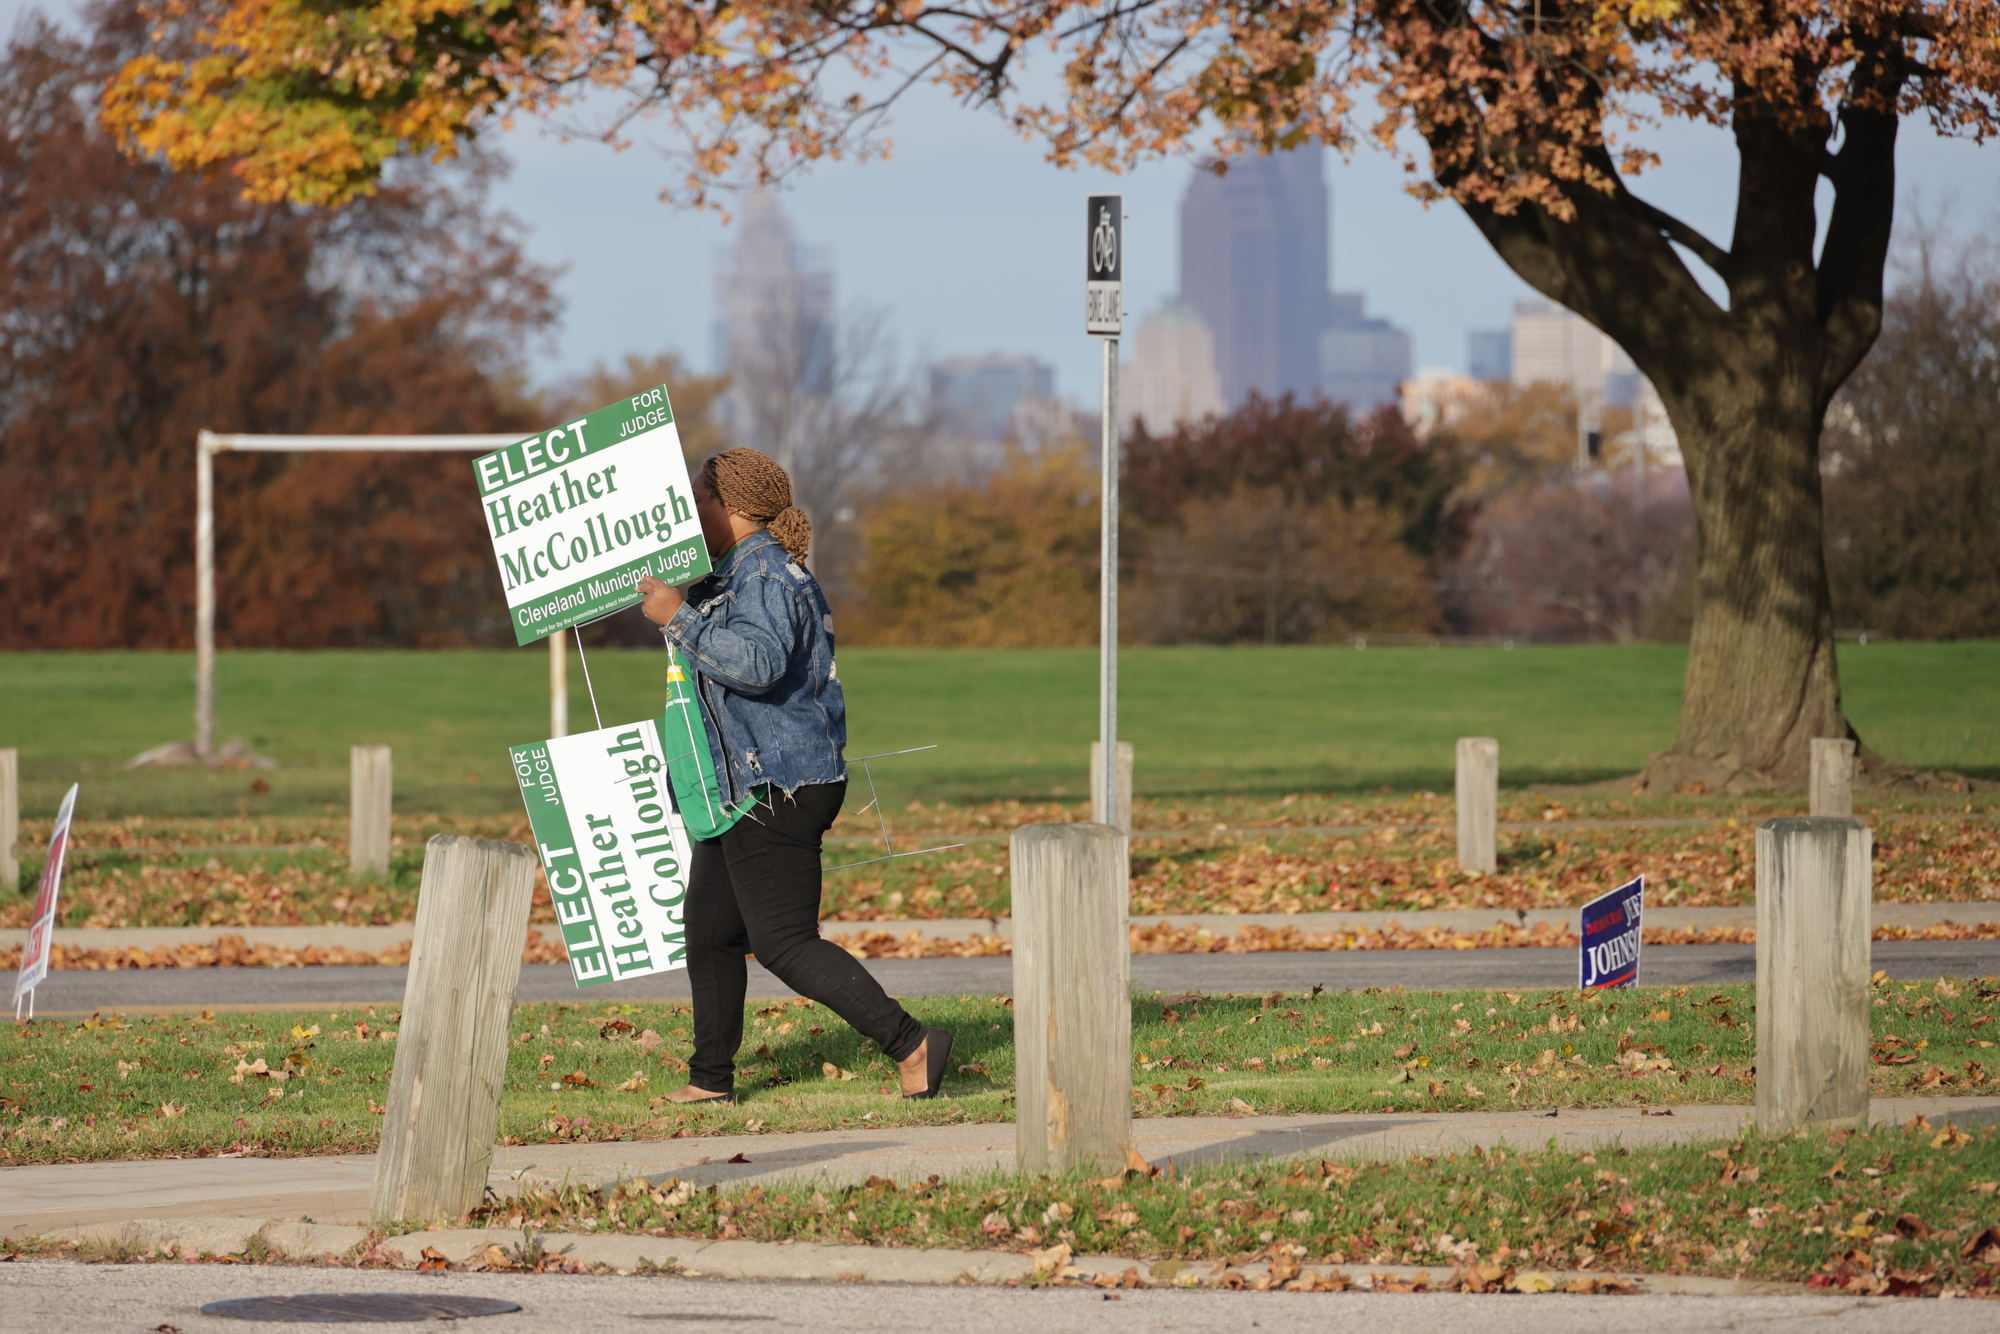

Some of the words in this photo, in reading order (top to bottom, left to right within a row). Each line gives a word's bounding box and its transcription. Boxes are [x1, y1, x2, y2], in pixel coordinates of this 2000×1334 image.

[619, 407, 668, 438] JUDGE
[631, 389, 663, 412] FOR
[478, 418, 588, 492] ELECT
[486, 464, 618, 539] Heather
[500, 485, 693, 591] McCollough
[518, 586, 586, 627] Cleveland
[588, 560, 653, 600] Municipal
[657, 547, 698, 574] Judge
[536, 625, 549, 636] Paid
[563, 617, 572, 625] the
[572, 608, 599, 622] committee
[605, 601, 618, 609] elect
[618, 592, 639, 604] Heather
[675, 571, 692, 582] Judge
[514, 751, 536, 788] FOR
[531, 747, 560, 806] JUDGE
[606, 728, 688, 966] McCollough
[540, 842, 609, 981] ELECT
[585, 813, 654, 977] Heather
[1622, 892, 1641, 927] JEF
